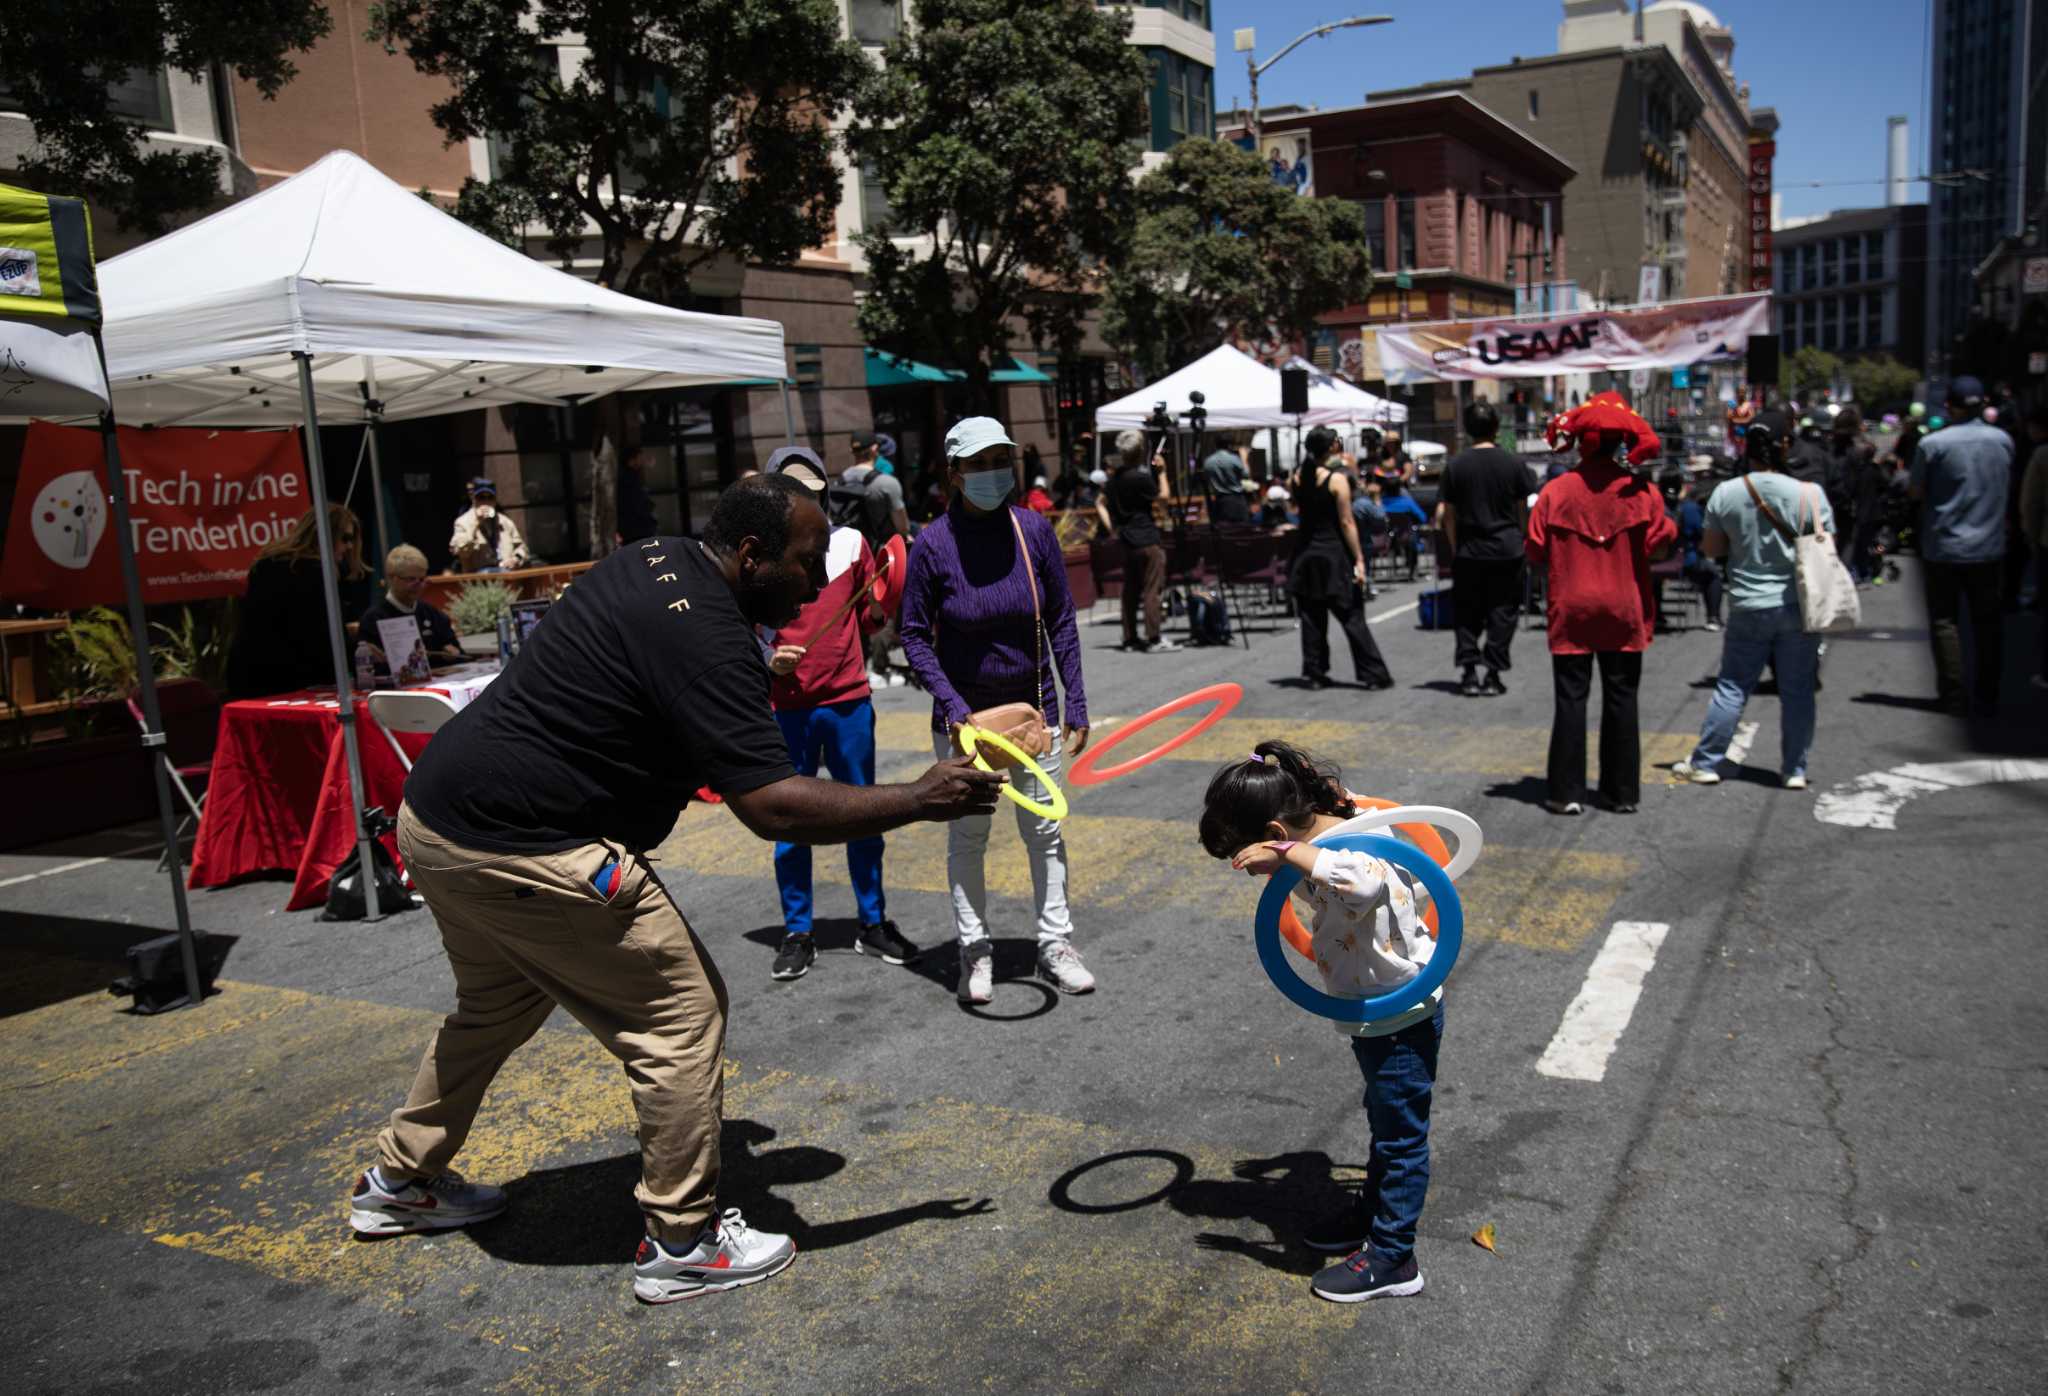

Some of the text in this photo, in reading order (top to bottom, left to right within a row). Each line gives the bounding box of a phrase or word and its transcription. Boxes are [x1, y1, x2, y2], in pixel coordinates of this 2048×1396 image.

[1751, 158, 1770, 269] GOLDEN
[1476, 318, 1600, 365] USAAF
[122, 468, 201, 506] Tech
[213, 472, 243, 506] in
[641, 539, 691, 612] TAFF
